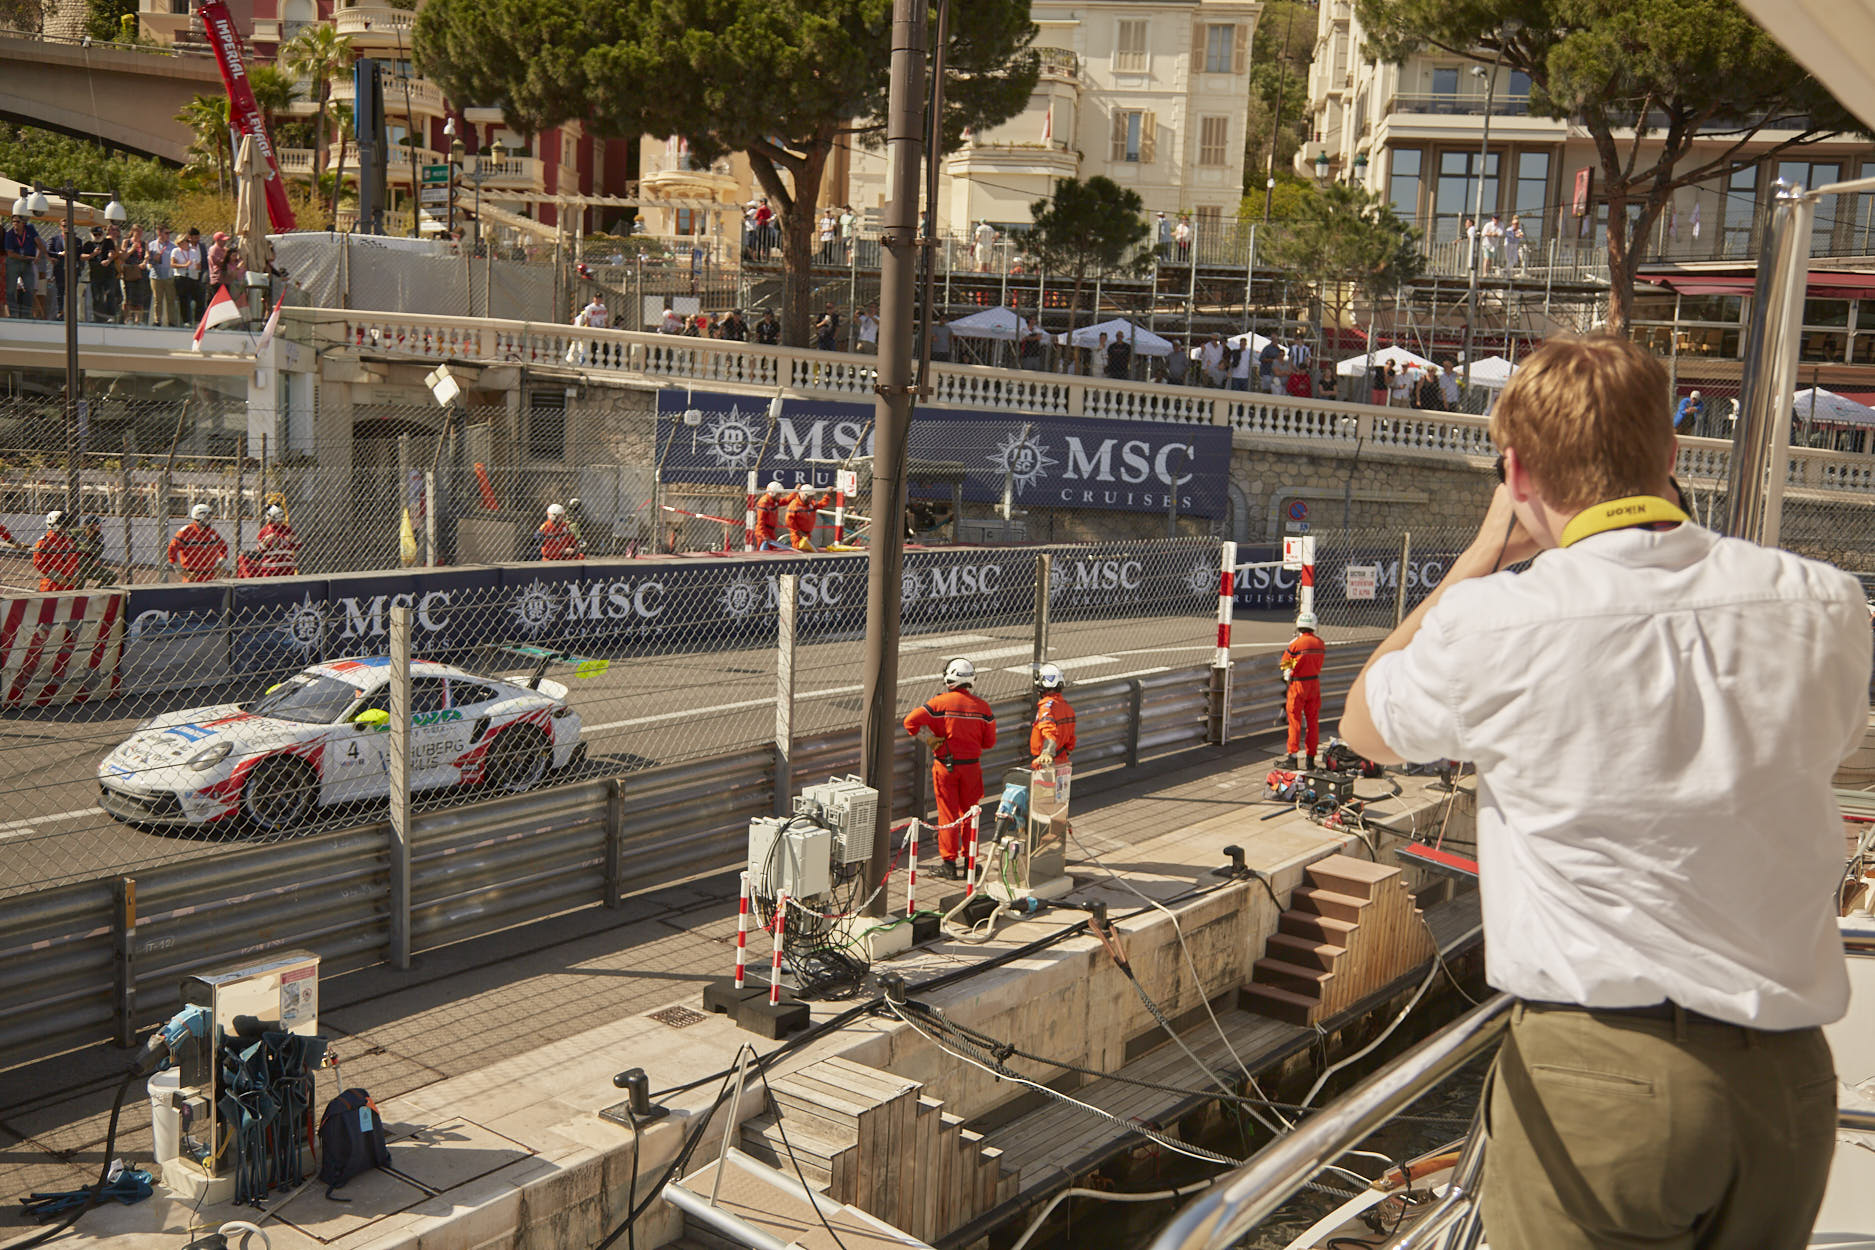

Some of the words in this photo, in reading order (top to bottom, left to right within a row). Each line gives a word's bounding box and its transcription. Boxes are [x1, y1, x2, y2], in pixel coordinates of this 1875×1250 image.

[216, 19, 245, 80] IMPERIAL
[247, 111, 272, 158] LEVAGE
[774, 417, 875, 461] MS
[773, 469, 829, 485] CRU
[1062, 436, 1194, 486] MSC
[1061, 488, 1191, 509] CRUISES
[930, 565, 1000, 598] MSC
[1074, 560, 1142, 590] MSC
[567, 582, 664, 621] MSC
[1233, 594, 1294, 603] RUISES
[347, 741, 360, 759] 4
